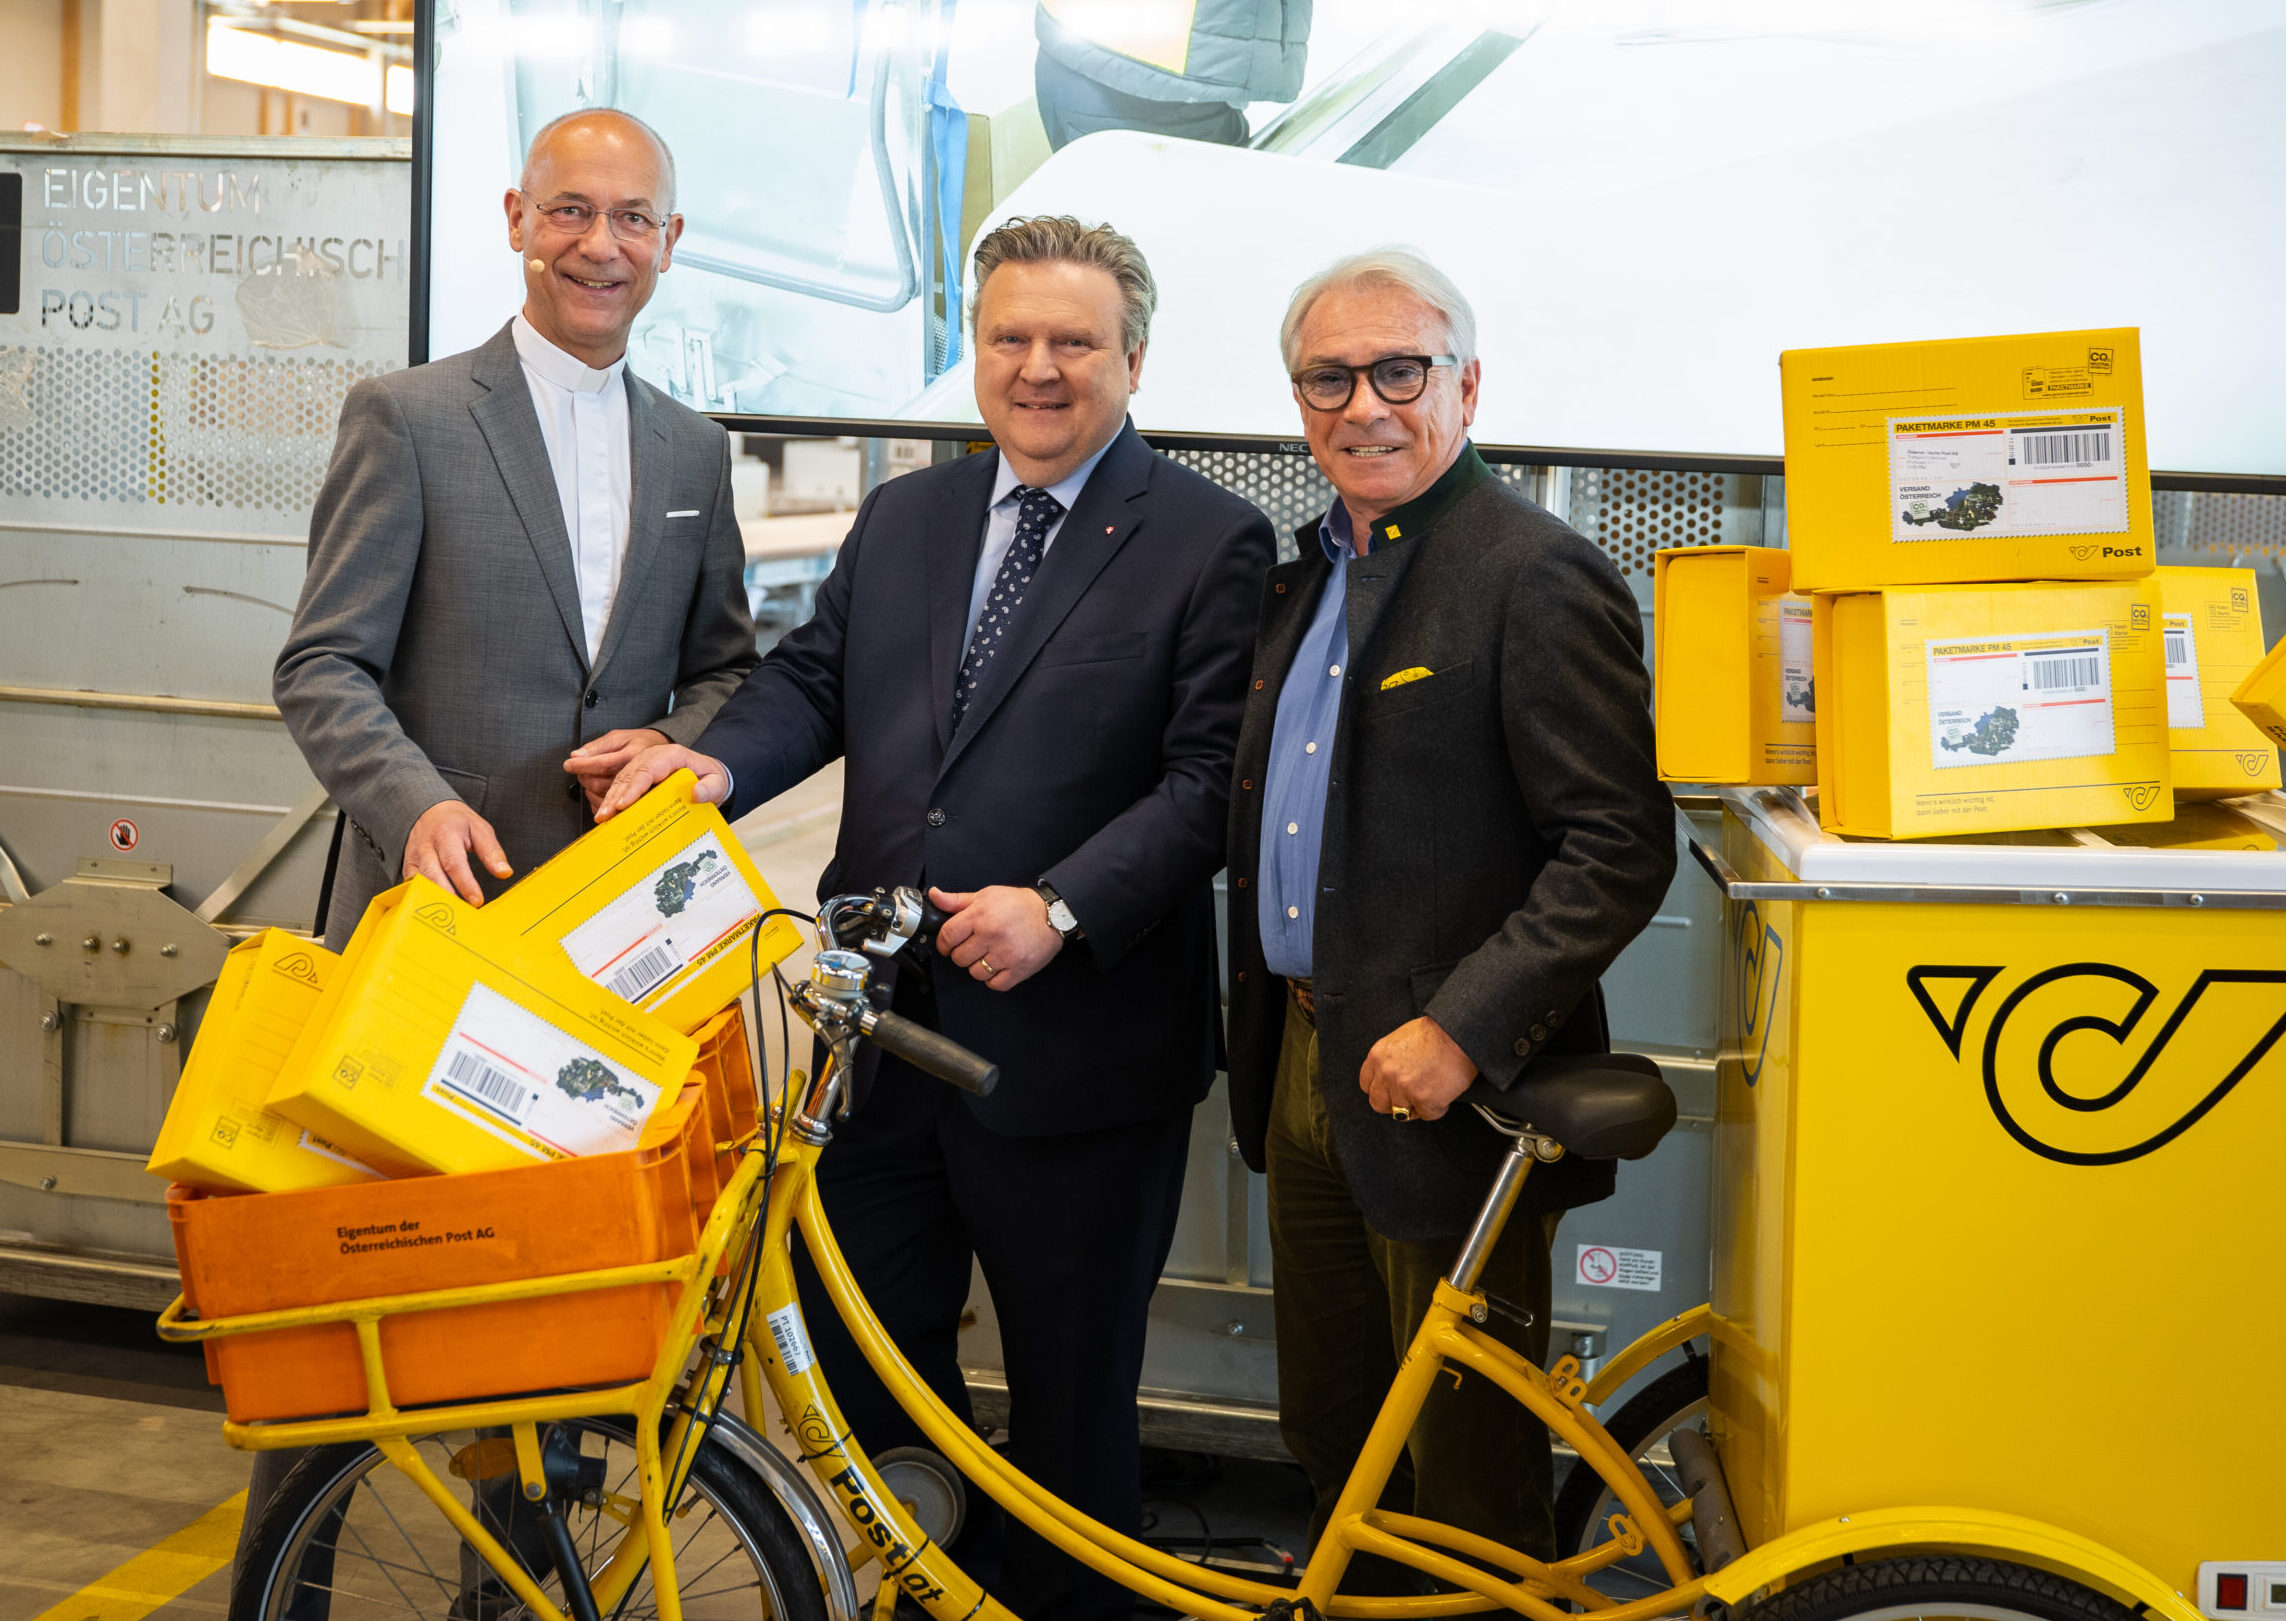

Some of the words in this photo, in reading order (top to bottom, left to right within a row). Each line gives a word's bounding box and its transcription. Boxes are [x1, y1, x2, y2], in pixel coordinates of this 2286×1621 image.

[43, 167, 261, 214] EIGENTUM
[42, 220, 405, 280] ÖSTERREICHISCH
[41, 288, 149, 331] POST
[157, 293, 216, 334] AG
[1896, 421, 1963, 432] PAKETMARKE
[1965, 420, 1981, 429] PM
[1983, 420, 1996, 428] 45
[1280, 443, 1308, 452] NEC
[1899, 492, 1941, 500] ÖSTERREICH
[2102, 546, 2143, 558] Post
[1933, 645, 1986, 655] PAKETMARKE
[1988, 643, 2000, 651] PM
[709, 870, 731, 887] VERSAND
[705, 947, 718, 958] PM
[696, 956, 707, 966] 45
[337, 1223, 397, 1240] Eigentum
[400, 1220, 420, 1232] der
[340, 1235, 443, 1254] Österreichischen
[446, 1231, 472, 1243] Post
[476, 1227, 495, 1239] AG
[779, 1314, 790, 1326] PT
